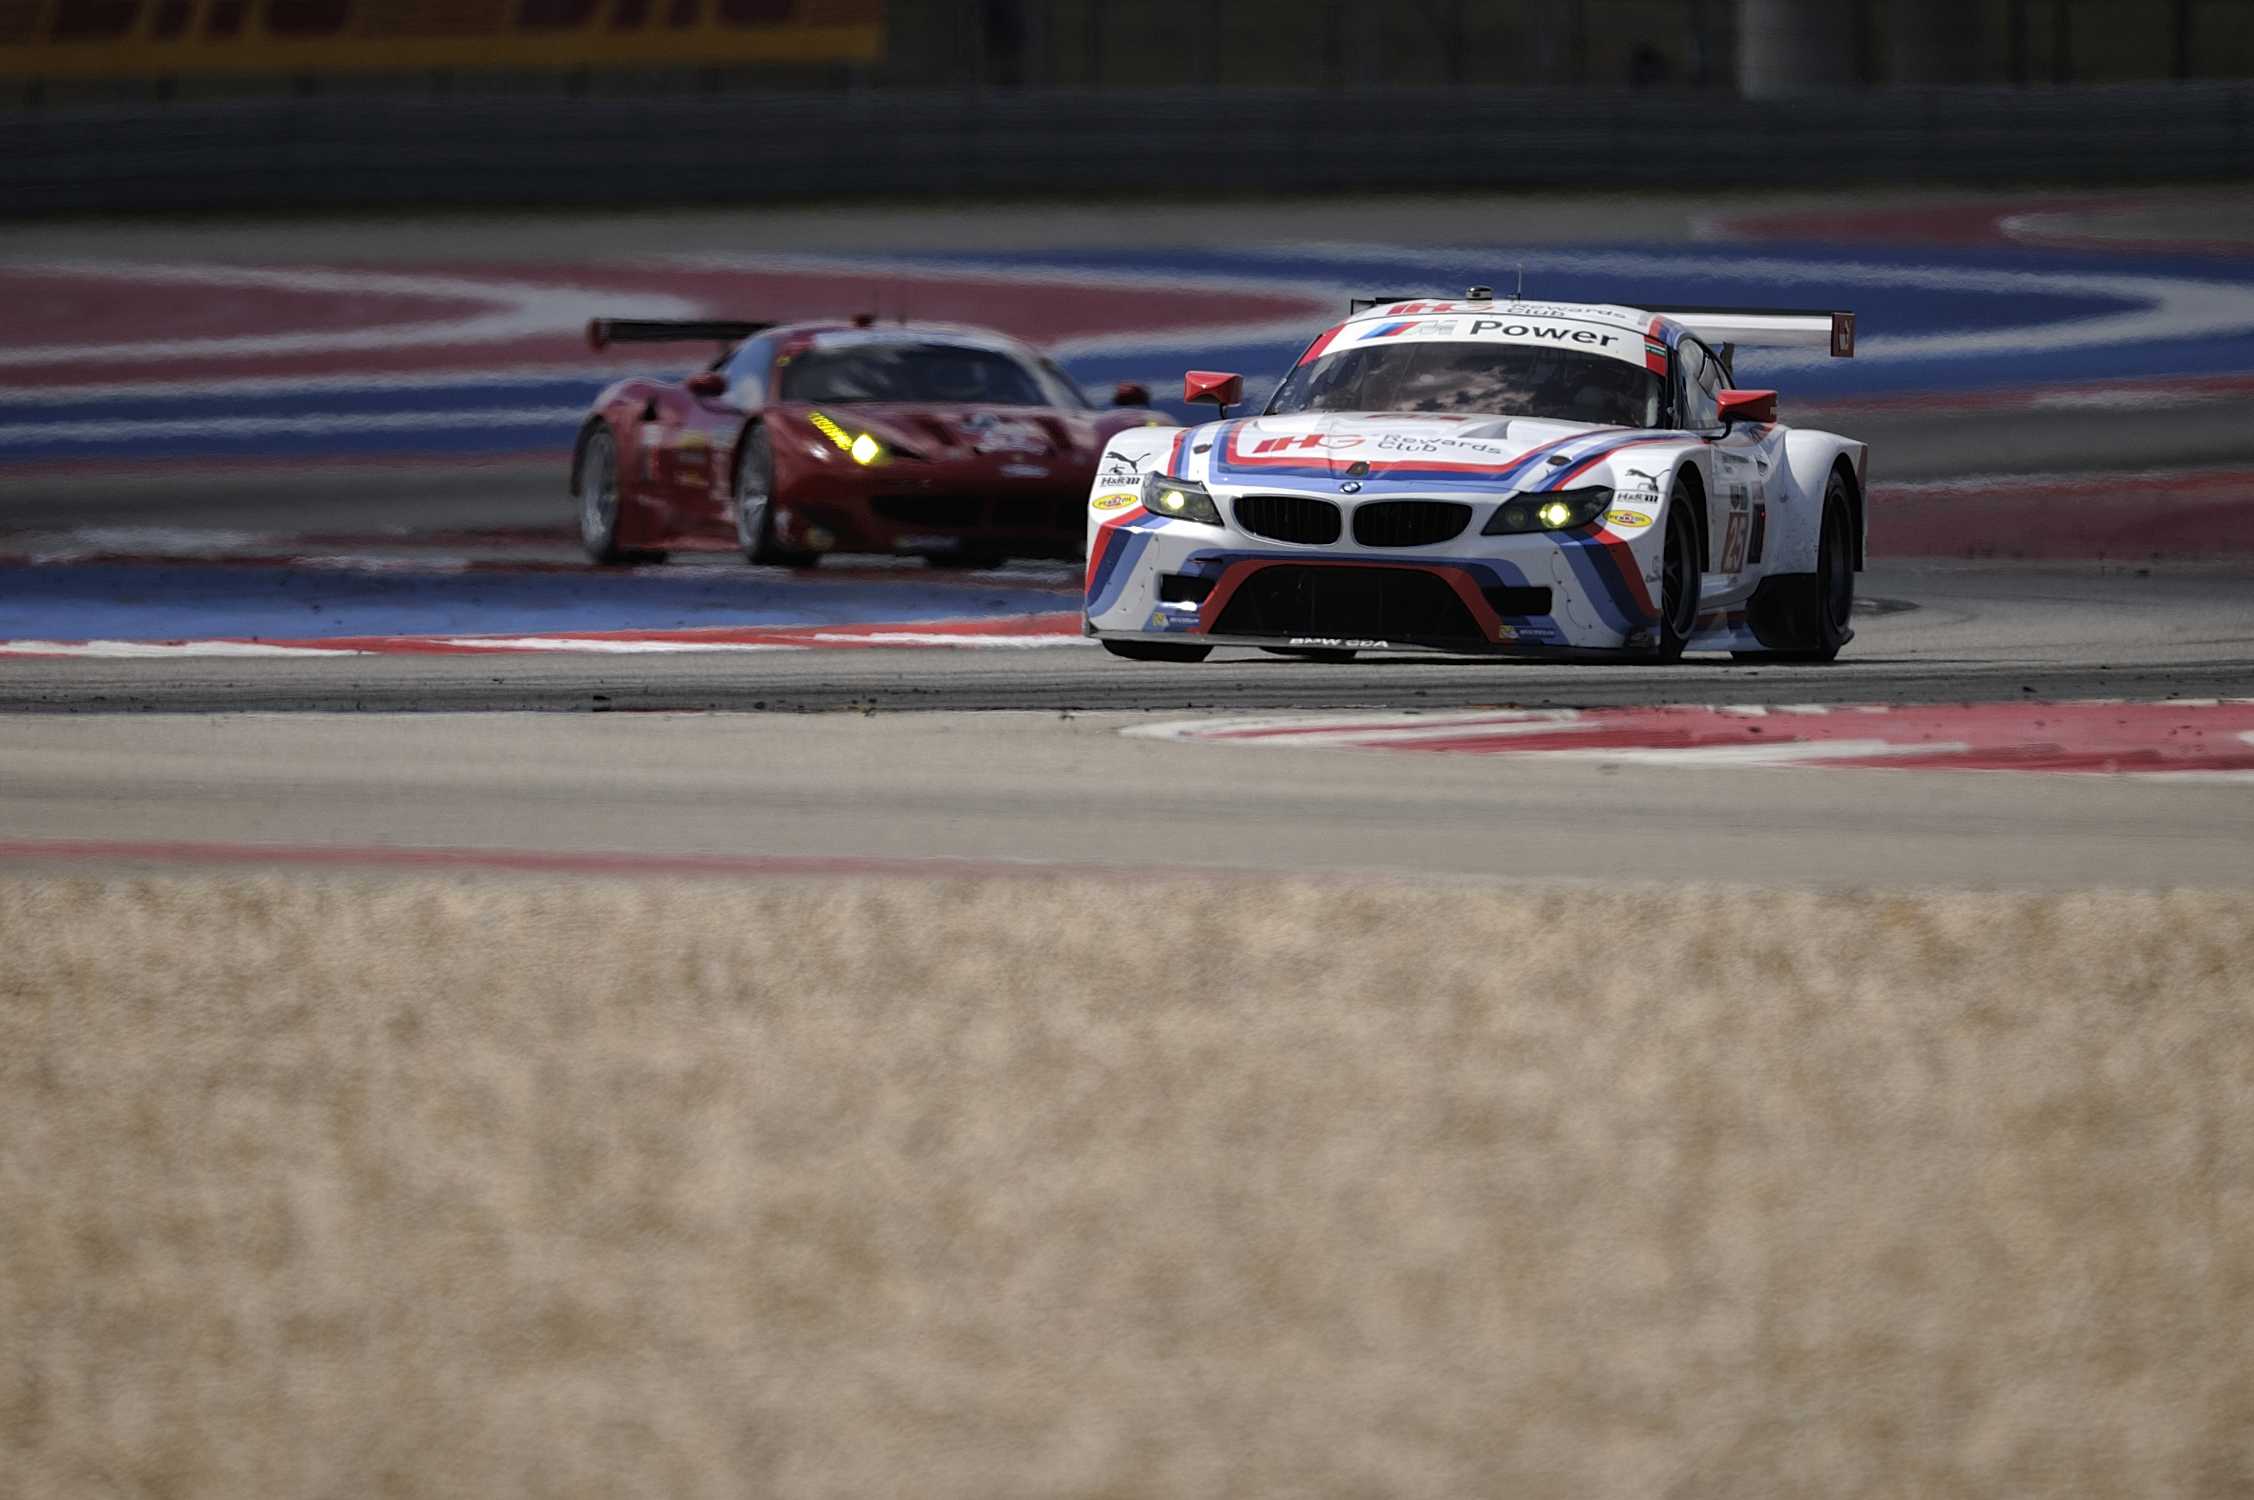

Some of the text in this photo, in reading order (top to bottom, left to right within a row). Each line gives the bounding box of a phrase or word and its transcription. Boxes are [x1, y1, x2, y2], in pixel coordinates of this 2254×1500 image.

[1470, 320, 1619, 347] Power
[1377, 441, 1438, 453] Club
[1382, 433, 1502, 455] Rewards
